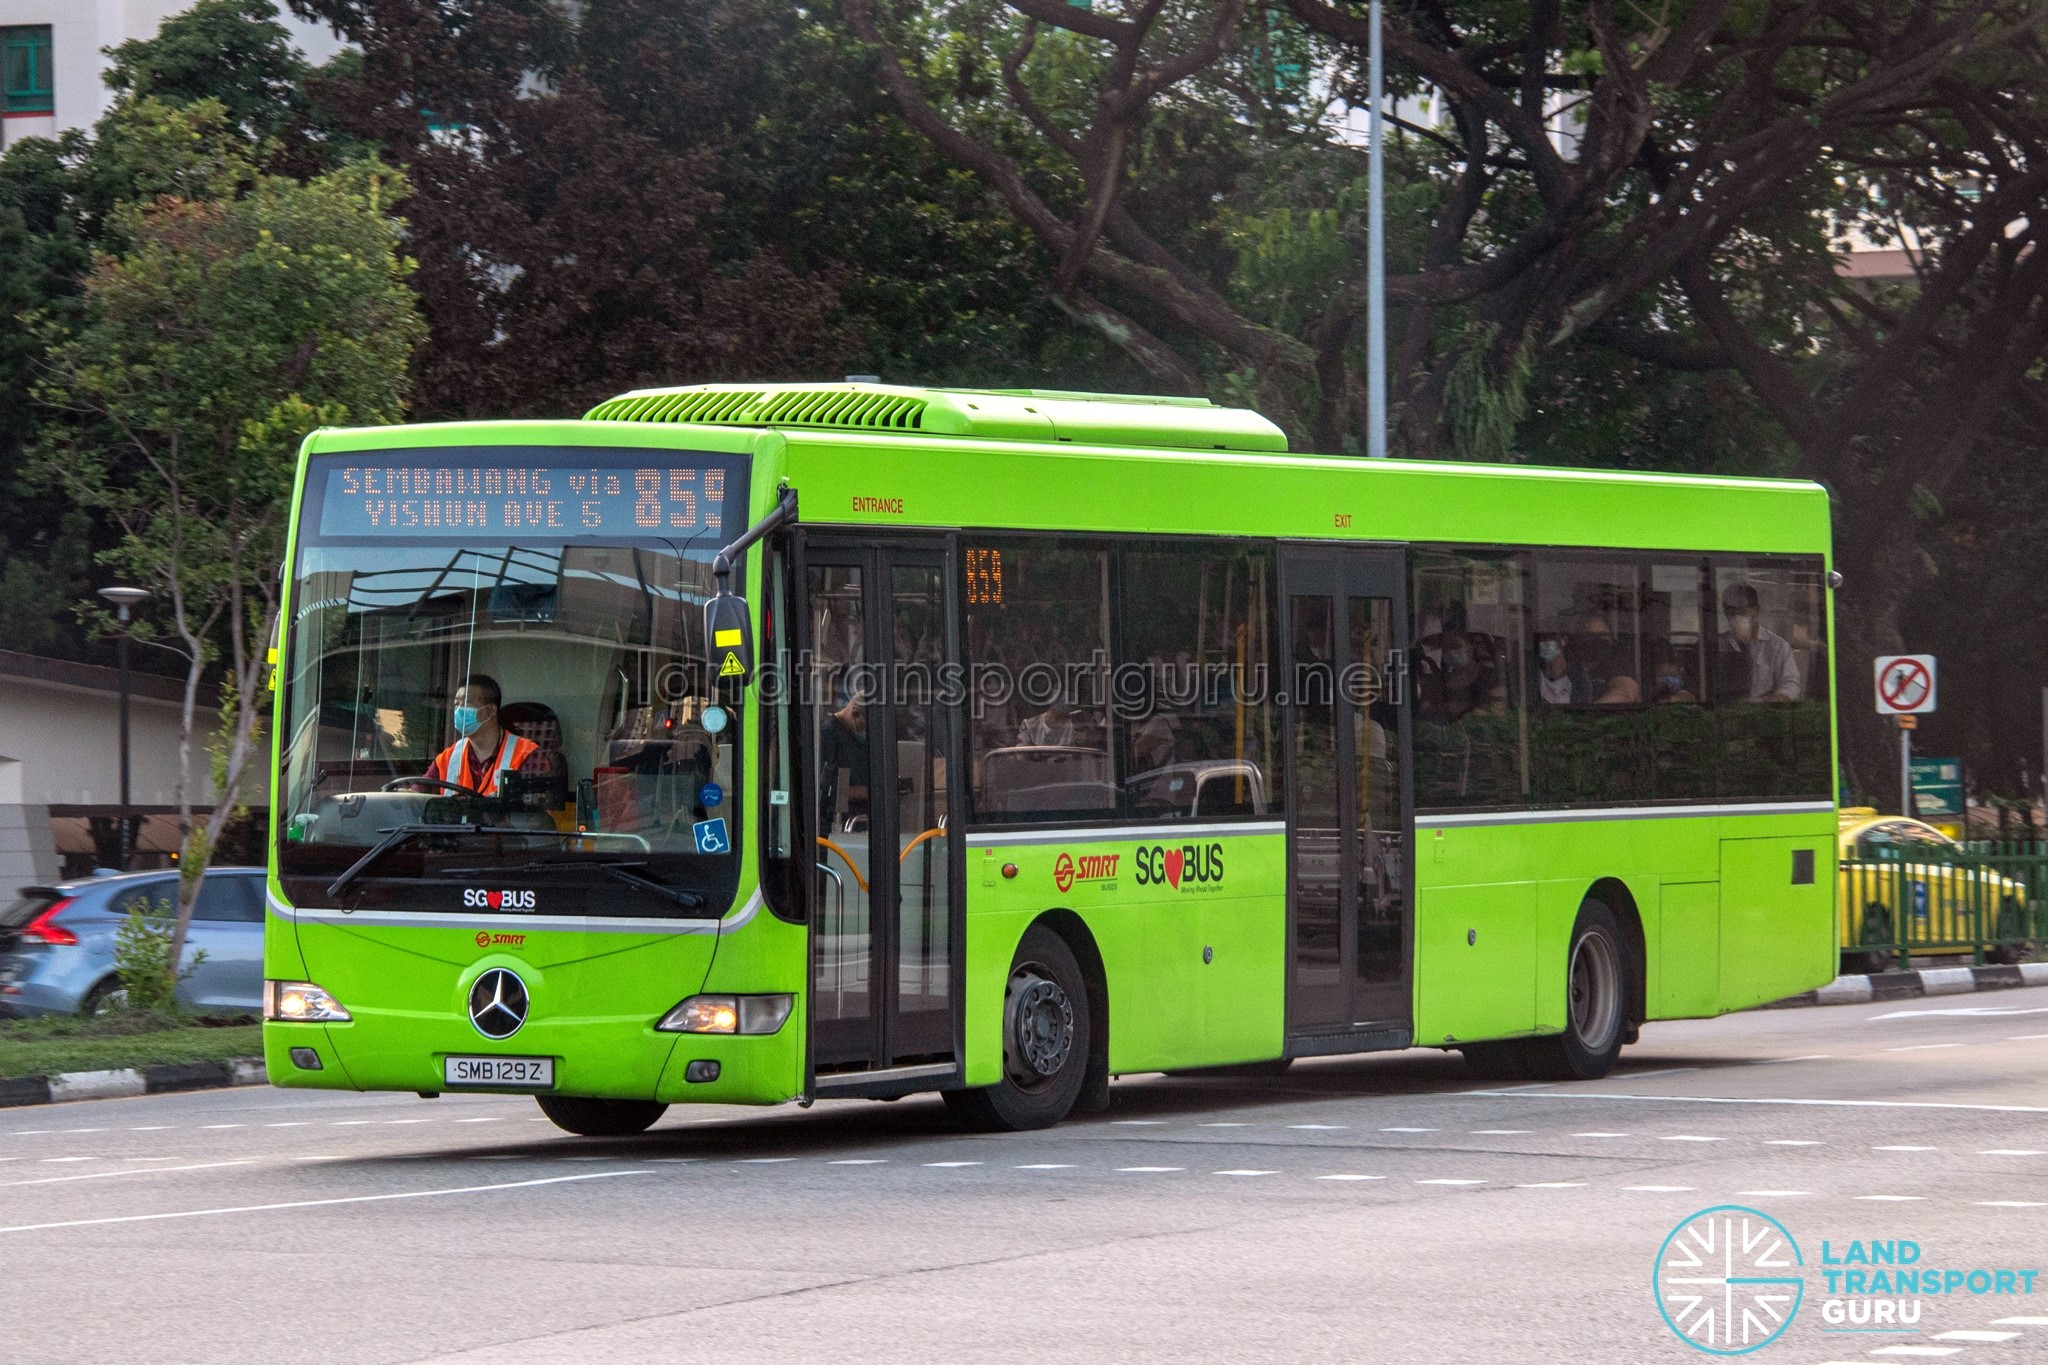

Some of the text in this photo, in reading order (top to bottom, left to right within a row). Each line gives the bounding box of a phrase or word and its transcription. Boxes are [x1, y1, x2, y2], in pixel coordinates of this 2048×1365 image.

[342, 467, 620, 495] SEMBAWANG via
[635, 468, 726, 528] 859
[852, 496, 904, 514] ENTRANCE
[365, 500, 602, 527] YISHUN AVE 5
[1334, 513, 1352, 528] EXIT
[966, 549, 1002, 604] 859
[1076, 854, 1120, 879] SMRT
[492, 934, 526, 945] SMRT
[457, 1061, 541, 1080] SMB129Z
